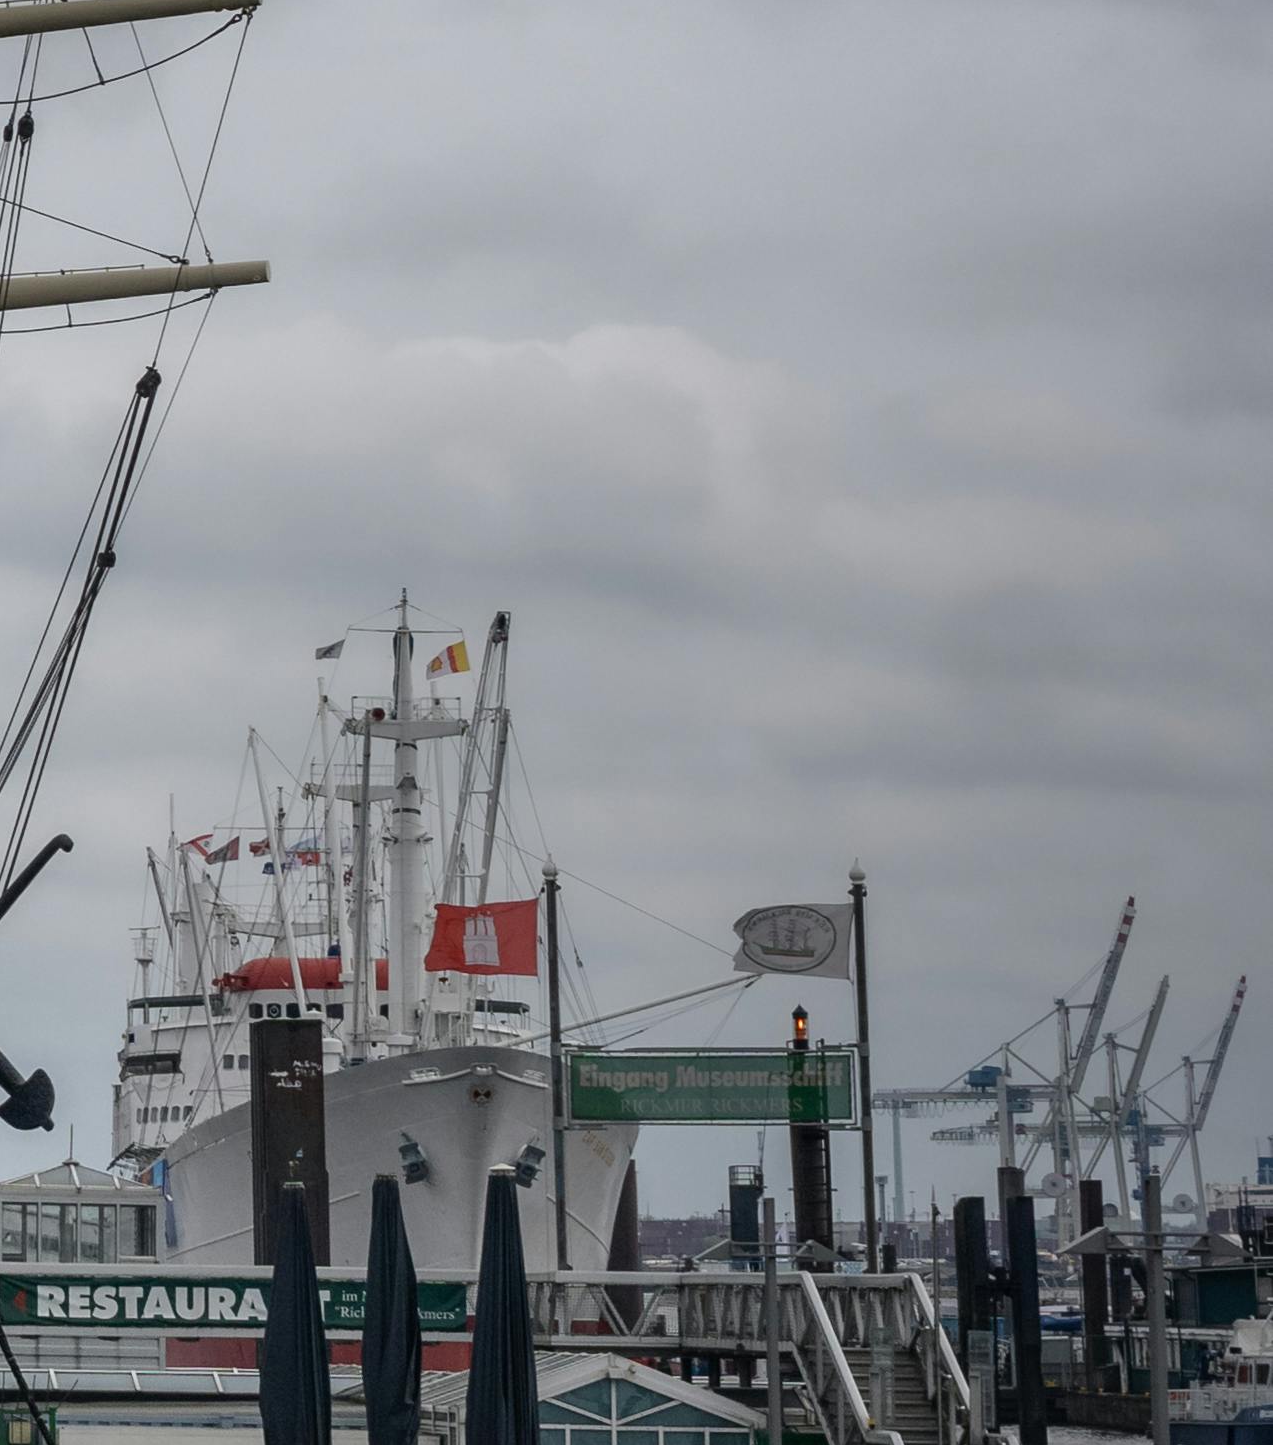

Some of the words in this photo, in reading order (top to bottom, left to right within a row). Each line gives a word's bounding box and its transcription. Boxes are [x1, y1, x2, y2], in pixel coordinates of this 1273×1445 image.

[579, 1064, 670, 1093] Eingang
[676, 1064, 844, 1088] Museumsschiff
[620, 1098, 704, 1113] RICKMER
[709, 1098, 804, 1113] RICKMERS
[36, 1285, 331, 1322] RESTAURAT
